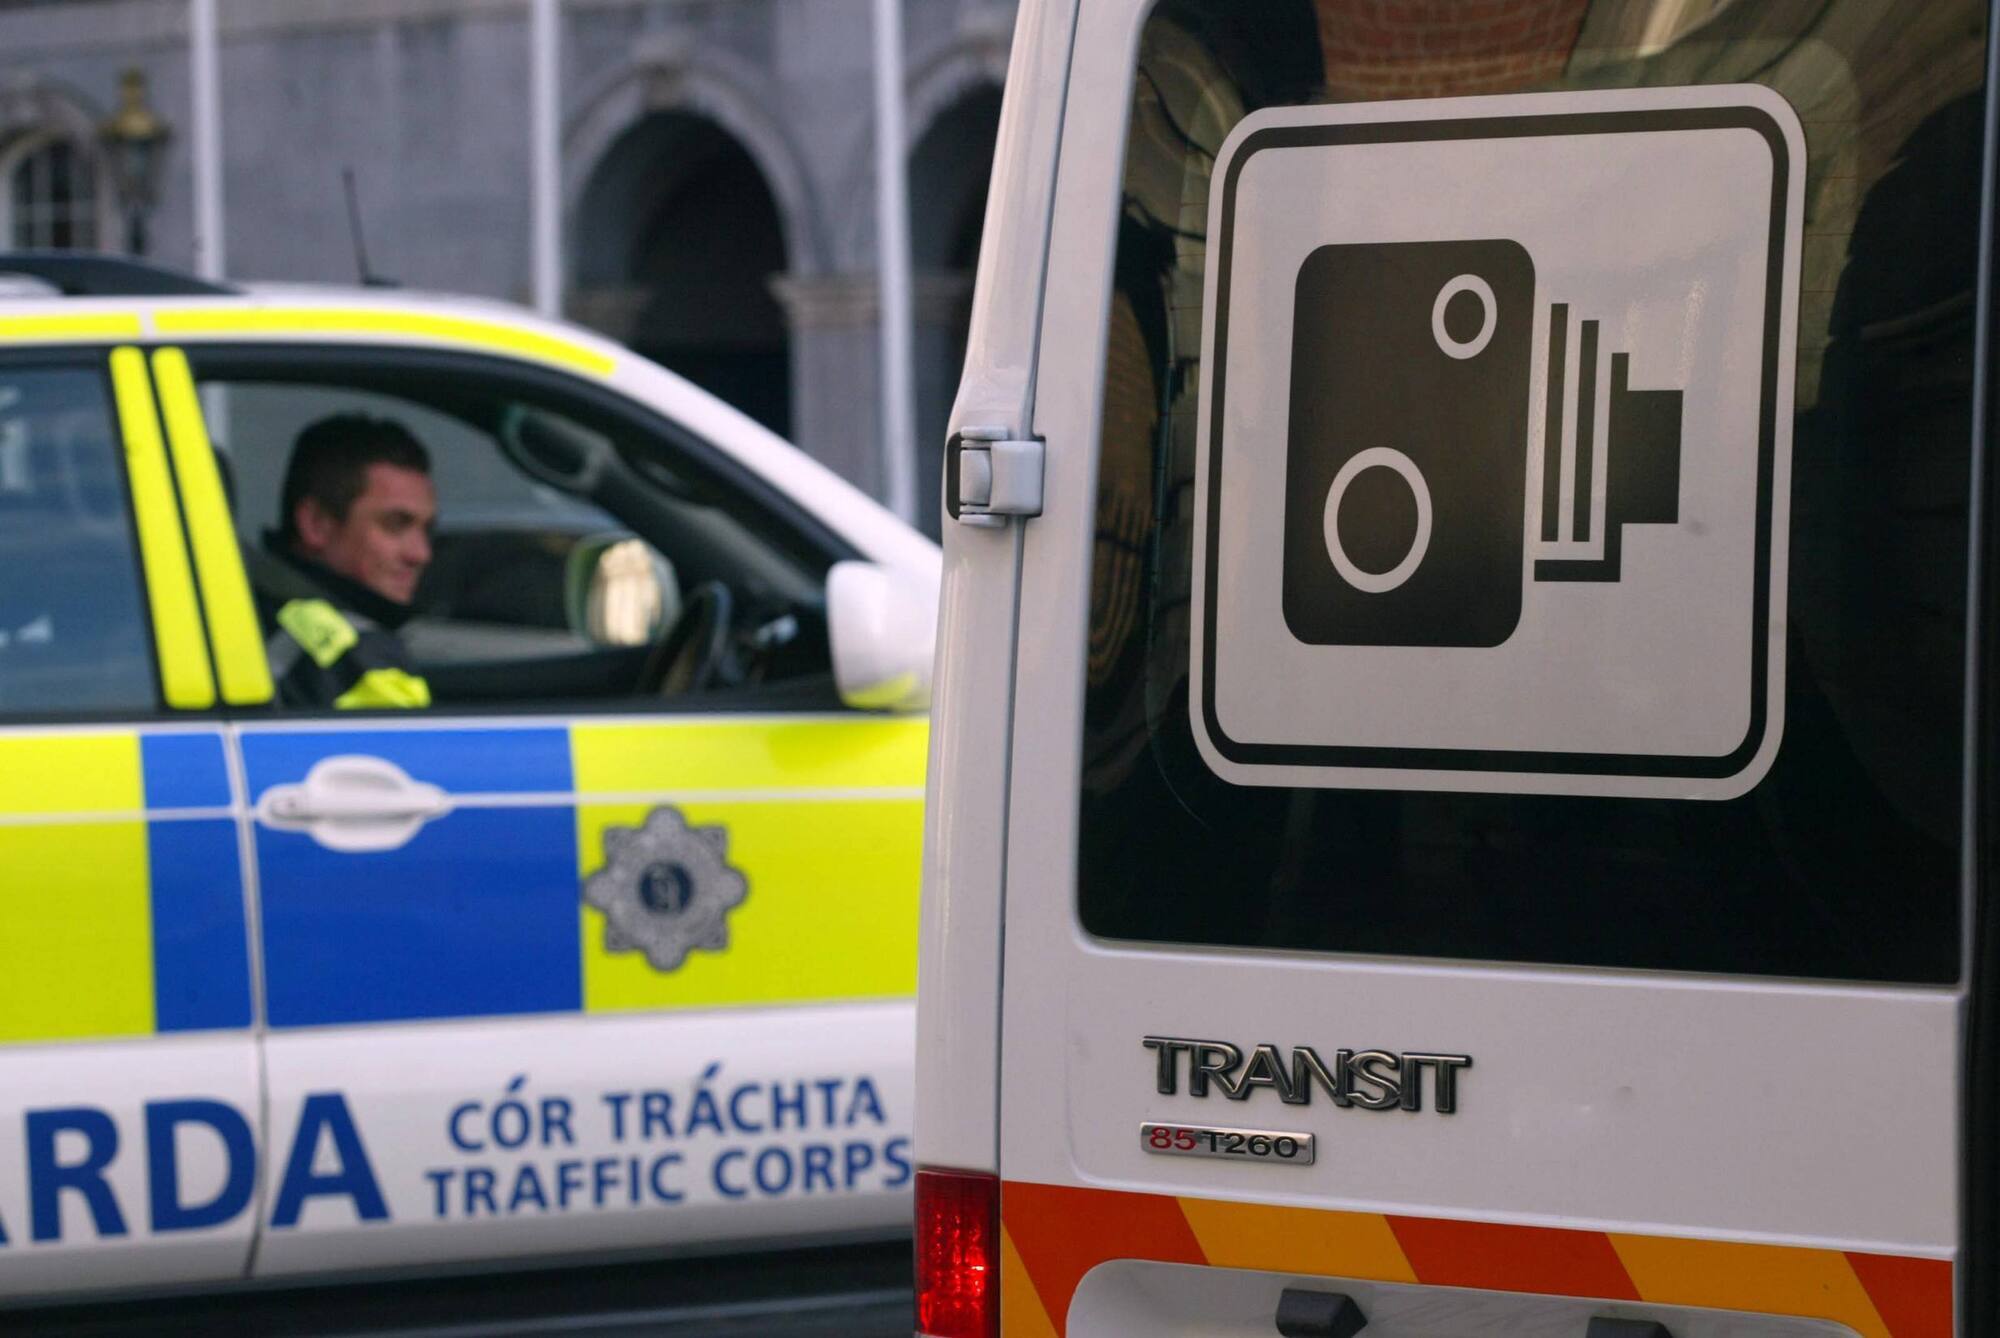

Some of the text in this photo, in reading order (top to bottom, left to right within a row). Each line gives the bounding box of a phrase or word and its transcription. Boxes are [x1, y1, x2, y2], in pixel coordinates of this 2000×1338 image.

[447, 1061, 885, 1152] CÓR TRÁCHTA
[1142, 1036, 1473, 1114] TRANSIT
[0, 1092, 390, 1247] RDA
[425, 1138, 914, 1217] TRAFFIC CORPS
[1150, 1128, 1298, 1158] 85 T260
